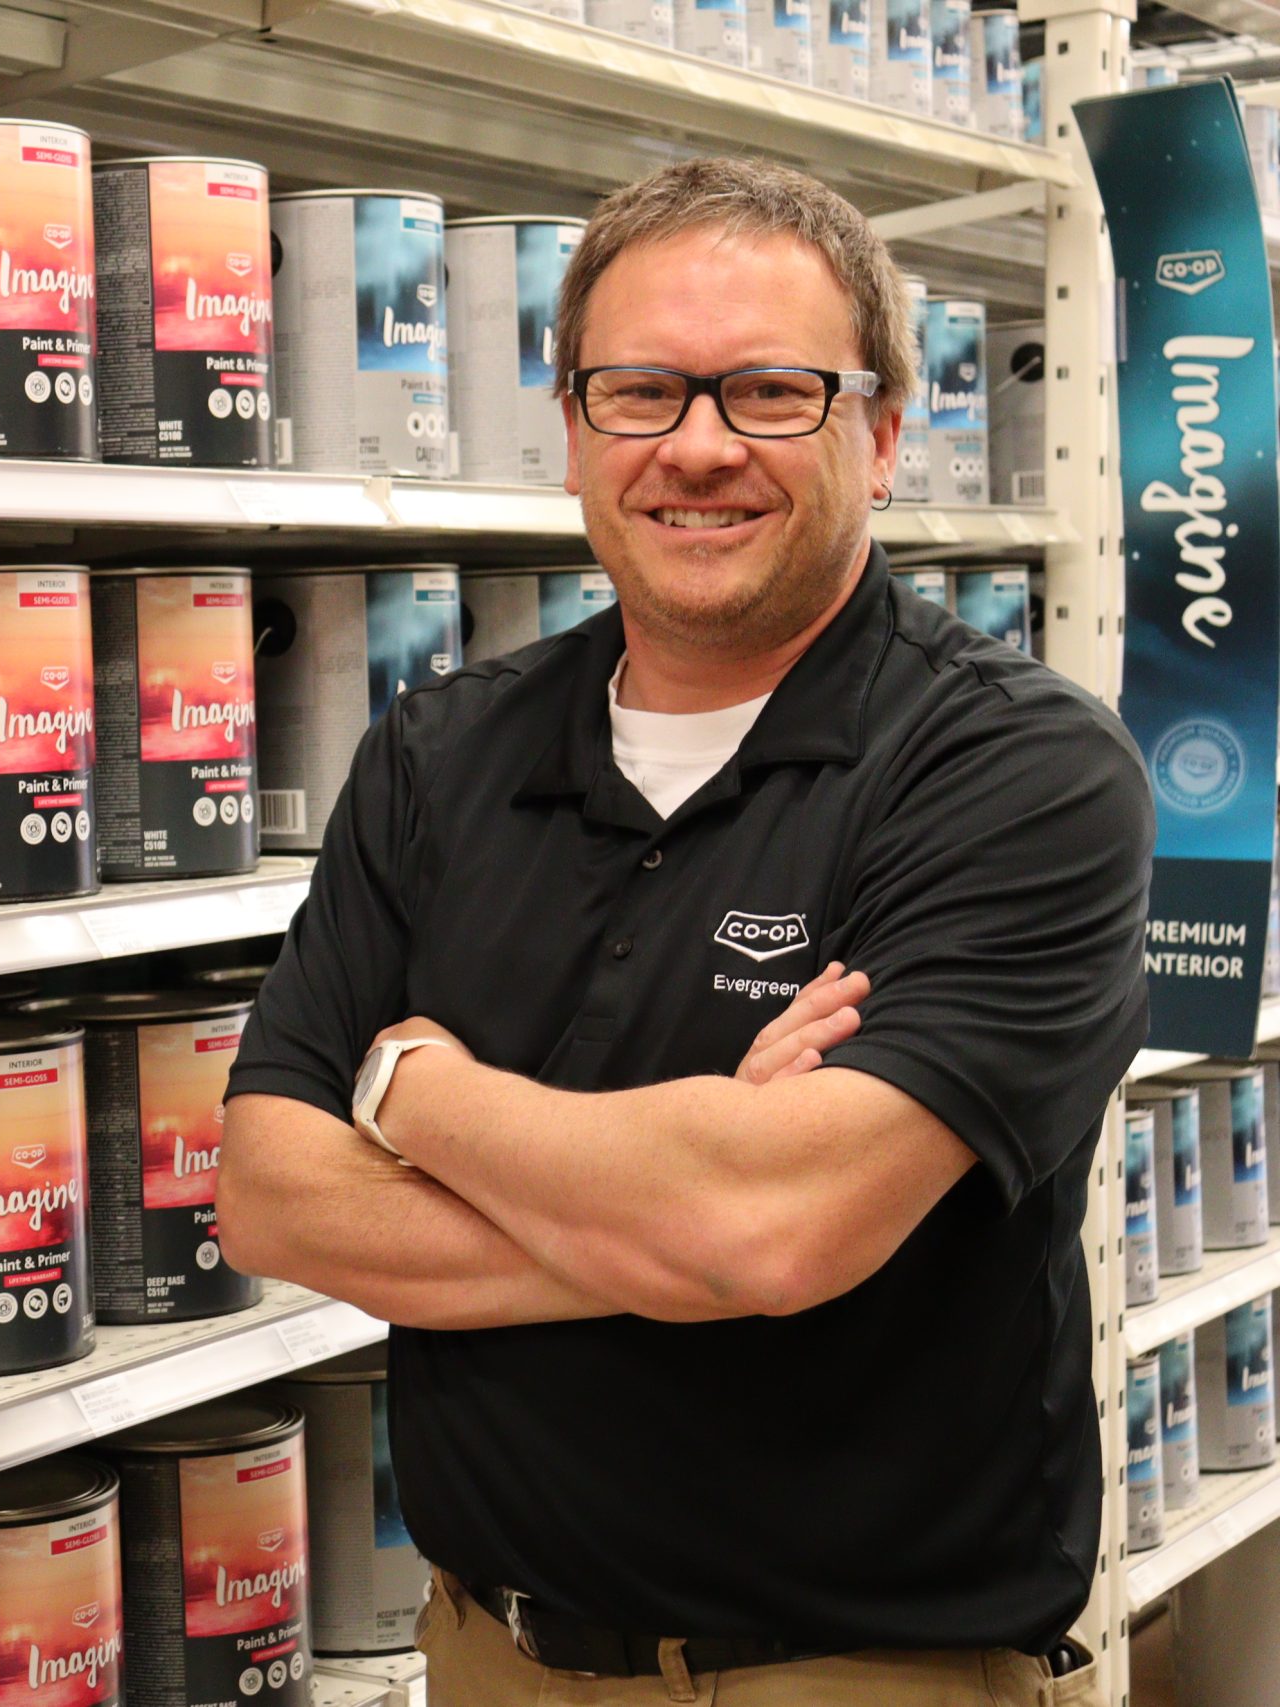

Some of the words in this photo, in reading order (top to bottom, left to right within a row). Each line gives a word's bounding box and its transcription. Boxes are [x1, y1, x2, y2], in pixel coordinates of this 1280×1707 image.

[1163, 258, 1217, 279] CO-OP
[186, 277, 271, 336] Imagin
[1140, 335, 1255, 648] Imagine
[727, 922, 798, 942] CO-OP
[1144, 953, 1243, 978] NTERIOR
[714, 974, 800, 999] Evergreen
[8, 1058, 43, 1069] INTERIOR
[4, 1073, 48, 1086] SEMI-GLOSS
[15, 1149, 44, 1160] CO-OP
[194, 1211, 217, 1224] Pain
[24, 1256, 35, 1270] &
[37, 1250, 70, 1267] Primer
